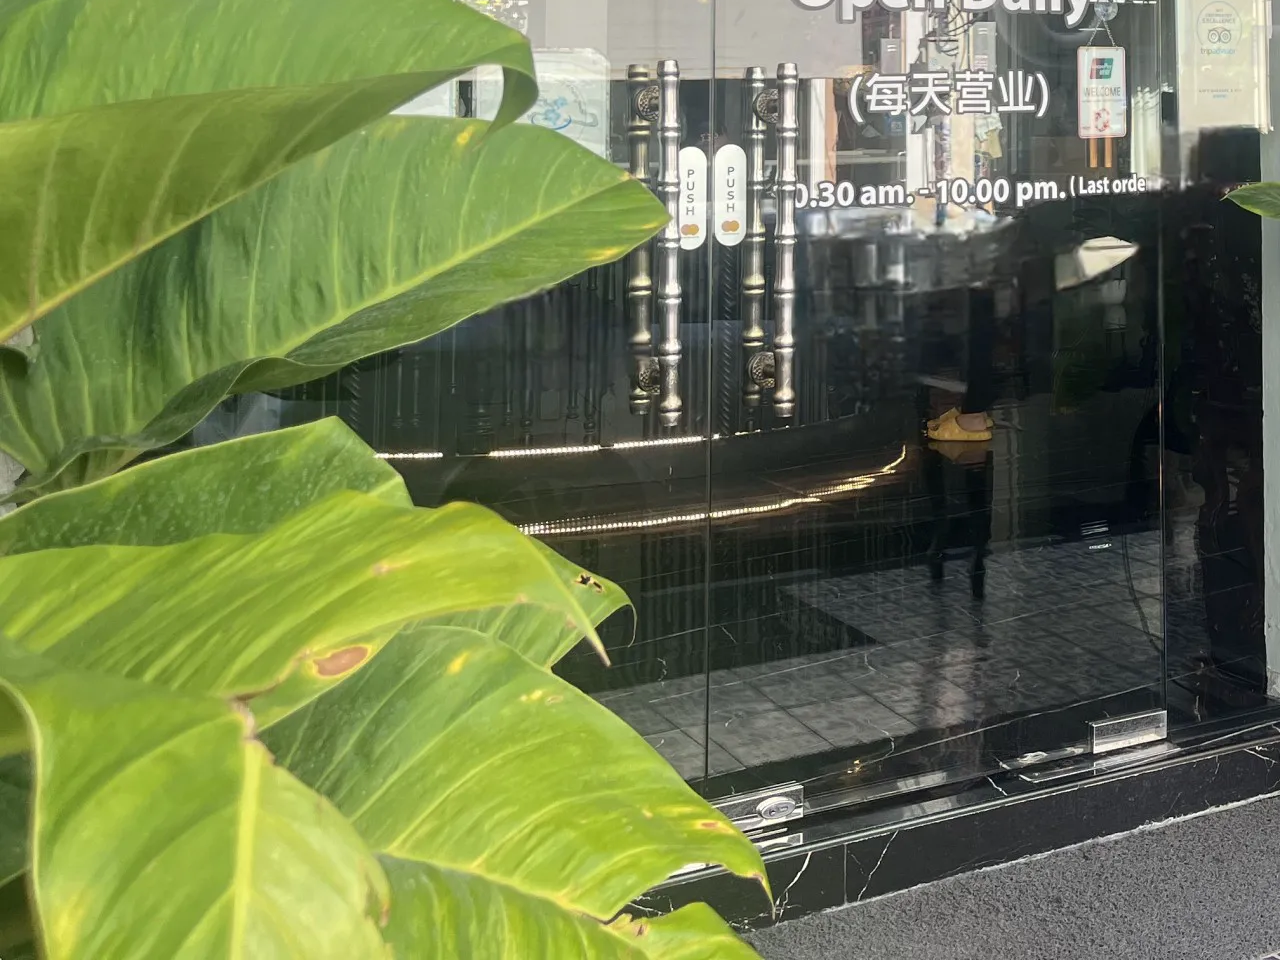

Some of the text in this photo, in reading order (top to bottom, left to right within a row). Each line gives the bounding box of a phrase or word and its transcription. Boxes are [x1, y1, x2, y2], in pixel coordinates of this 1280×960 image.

[848, 70, 1050, 124] (每天营业)
[1084, 86, 1121, 97] WELCOME
[686, 168, 695, 216] PUSH
[726, 166, 735, 213] PUSH
[784, 181, 855, 208] 0.30
[860, 182, 914, 208] am.
[936, 177, 1010, 205] 10.00
[1016, 179, 1066, 207] pm.
